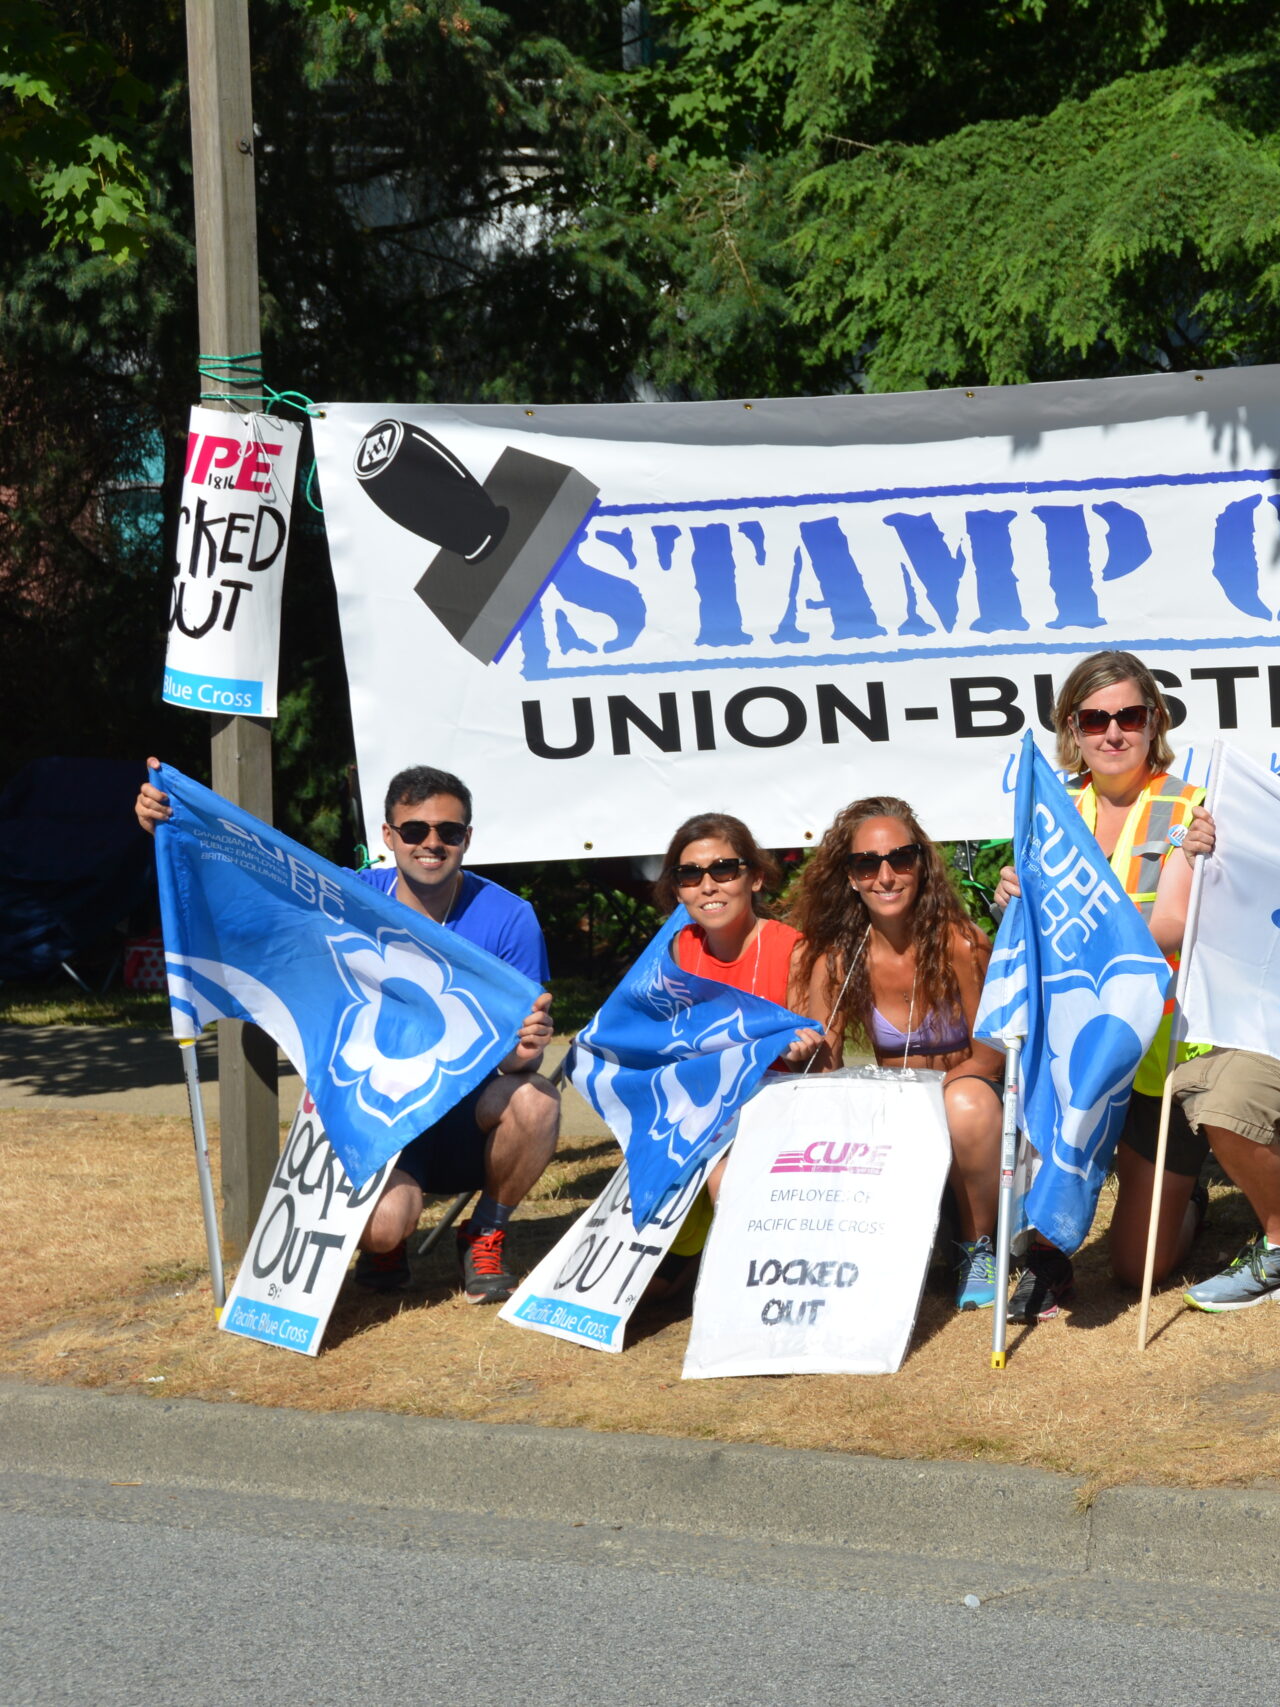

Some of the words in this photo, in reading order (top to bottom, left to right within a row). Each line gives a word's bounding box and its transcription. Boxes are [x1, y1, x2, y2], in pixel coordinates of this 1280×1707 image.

[207, 472, 236, 490] 1816
[551, 499, 1153, 655] STAMP
[168, 577, 253, 640] UT
[163, 674, 193, 700] Blue
[197, 684, 252, 708] Cross
[193, 828, 246, 848] CANADIAN
[201, 852, 238, 864] BRITISH
[1035, 802, 1121, 932] CUPE
[291, 870, 346, 925] BC
[1041, 887, 1092, 963] BC
[803, 1141, 893, 1166] CUPE
[747, 1218, 798, 1232] PACIFIC
[799, 1218, 835, 1232] BLUE
[252, 1193, 347, 1295] OUT
[553, 1233, 663, 1305] OUT
[746, 1258, 859, 1289] LOCKED
[232, 1305, 259, 1330] Pacific
[258, 1312, 279, 1336] Blue
[279, 1319, 309, 1344] Cross
[521, 1302, 553, 1322] Pacific
[550, 1306, 578, 1330] Blue
[760, 1298, 826, 1327] OUT
